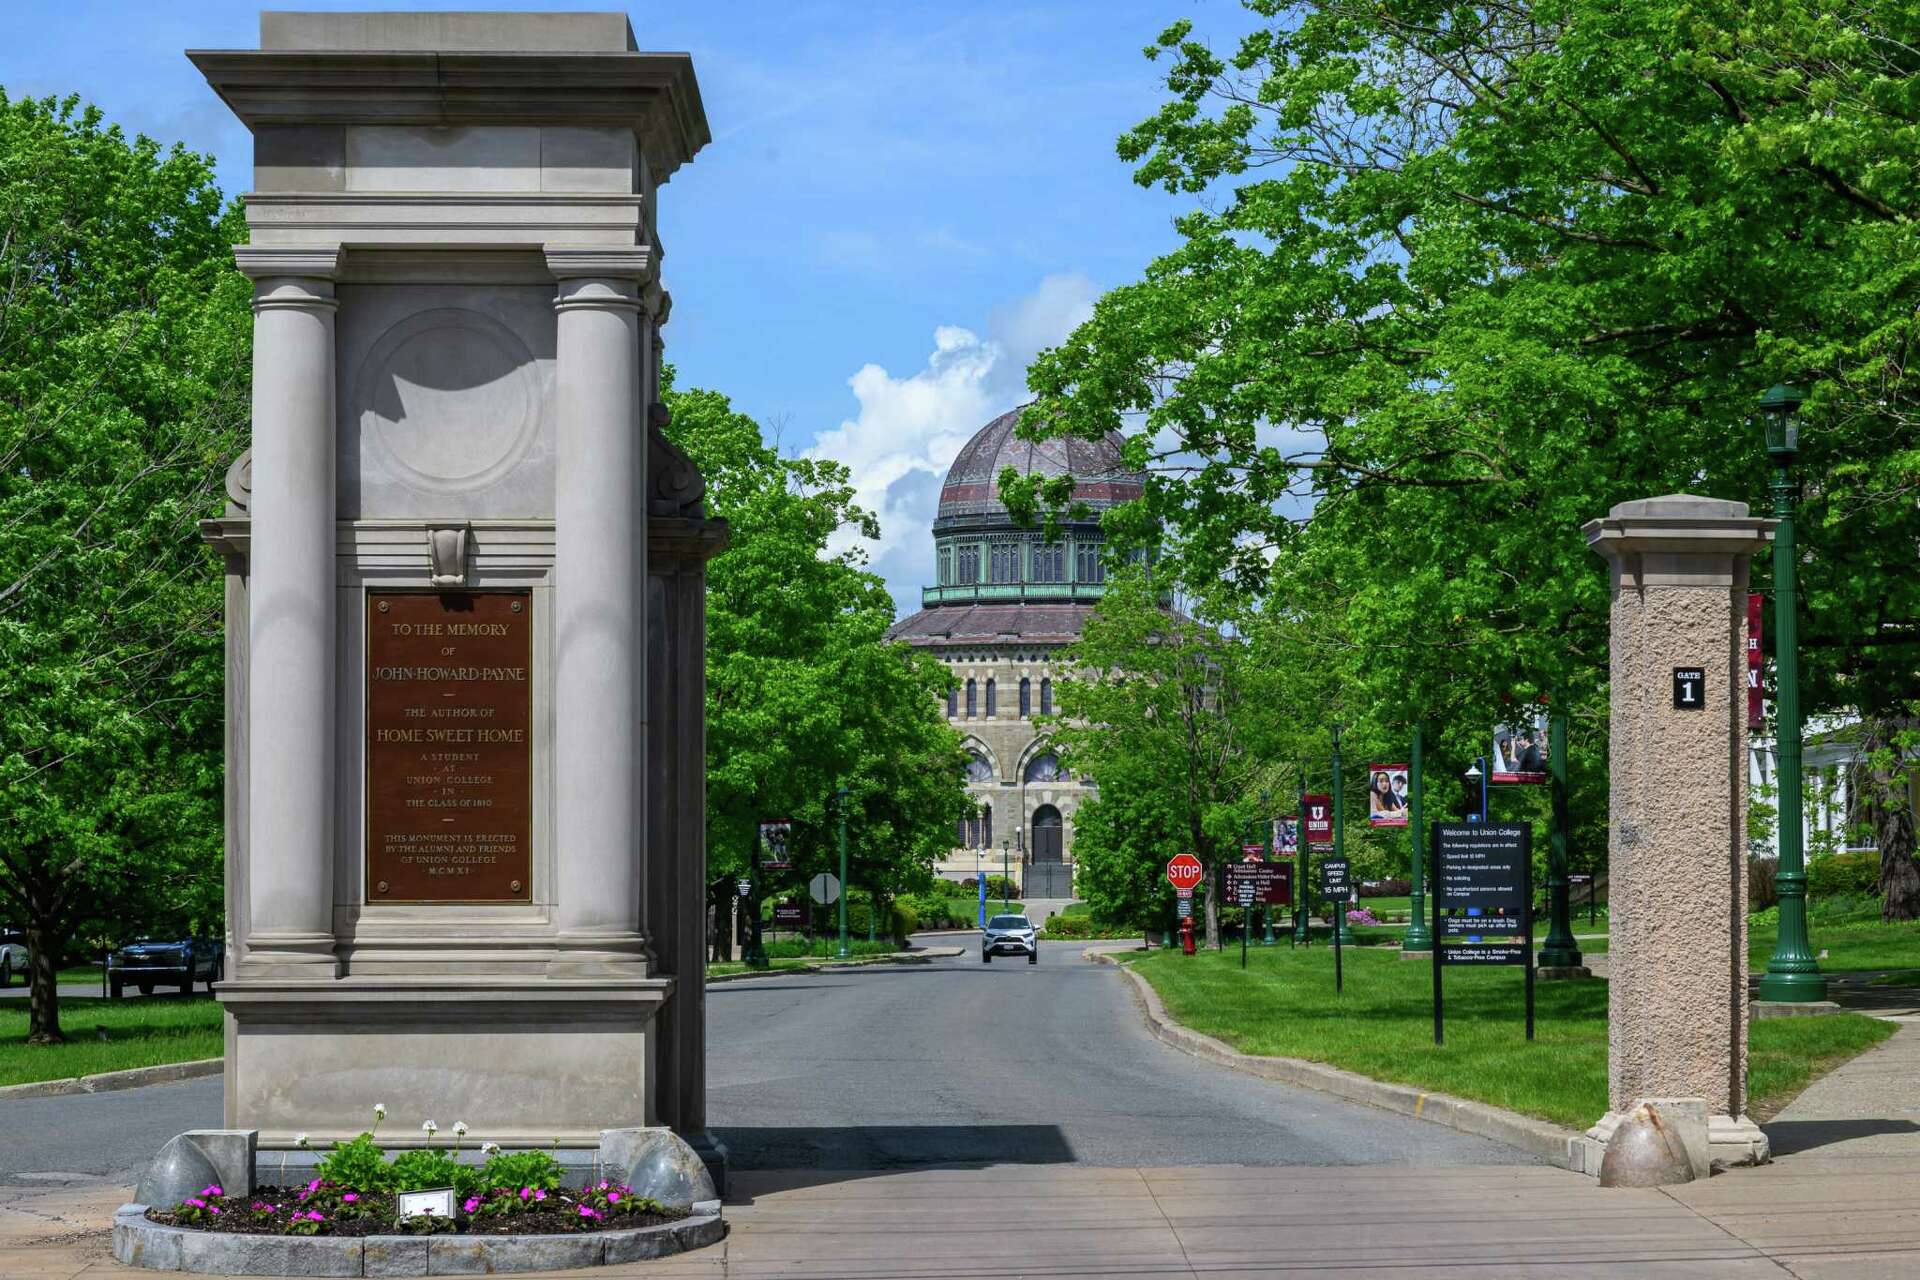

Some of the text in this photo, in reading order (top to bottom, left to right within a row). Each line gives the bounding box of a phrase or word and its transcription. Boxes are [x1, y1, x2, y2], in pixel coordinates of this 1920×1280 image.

[392, 623, 510, 636] TO THE MEMORY
[441, 647, 456, 656] OF
[1682, 682, 1695, 702] 1
[404, 708, 495, 717] THE AUTHOR OF
[376, 729, 523, 742] HOME SWEET HOME
[420, 753, 480, 761] A STUDENT
[406, 776, 493, 784] UNION COLLEGE
[1442, 829, 1521, 837] Welcome to Union College
[386, 835, 516, 843] THIS MONUMENT IS ERECTED
[385, 845, 516, 853] BY THE ALUMNI AND FRIENDS
[416, 856, 448, 864] UNION
[451, 856, 497, 864] COLLEGE
[1170, 865, 1200, 879] STOP
